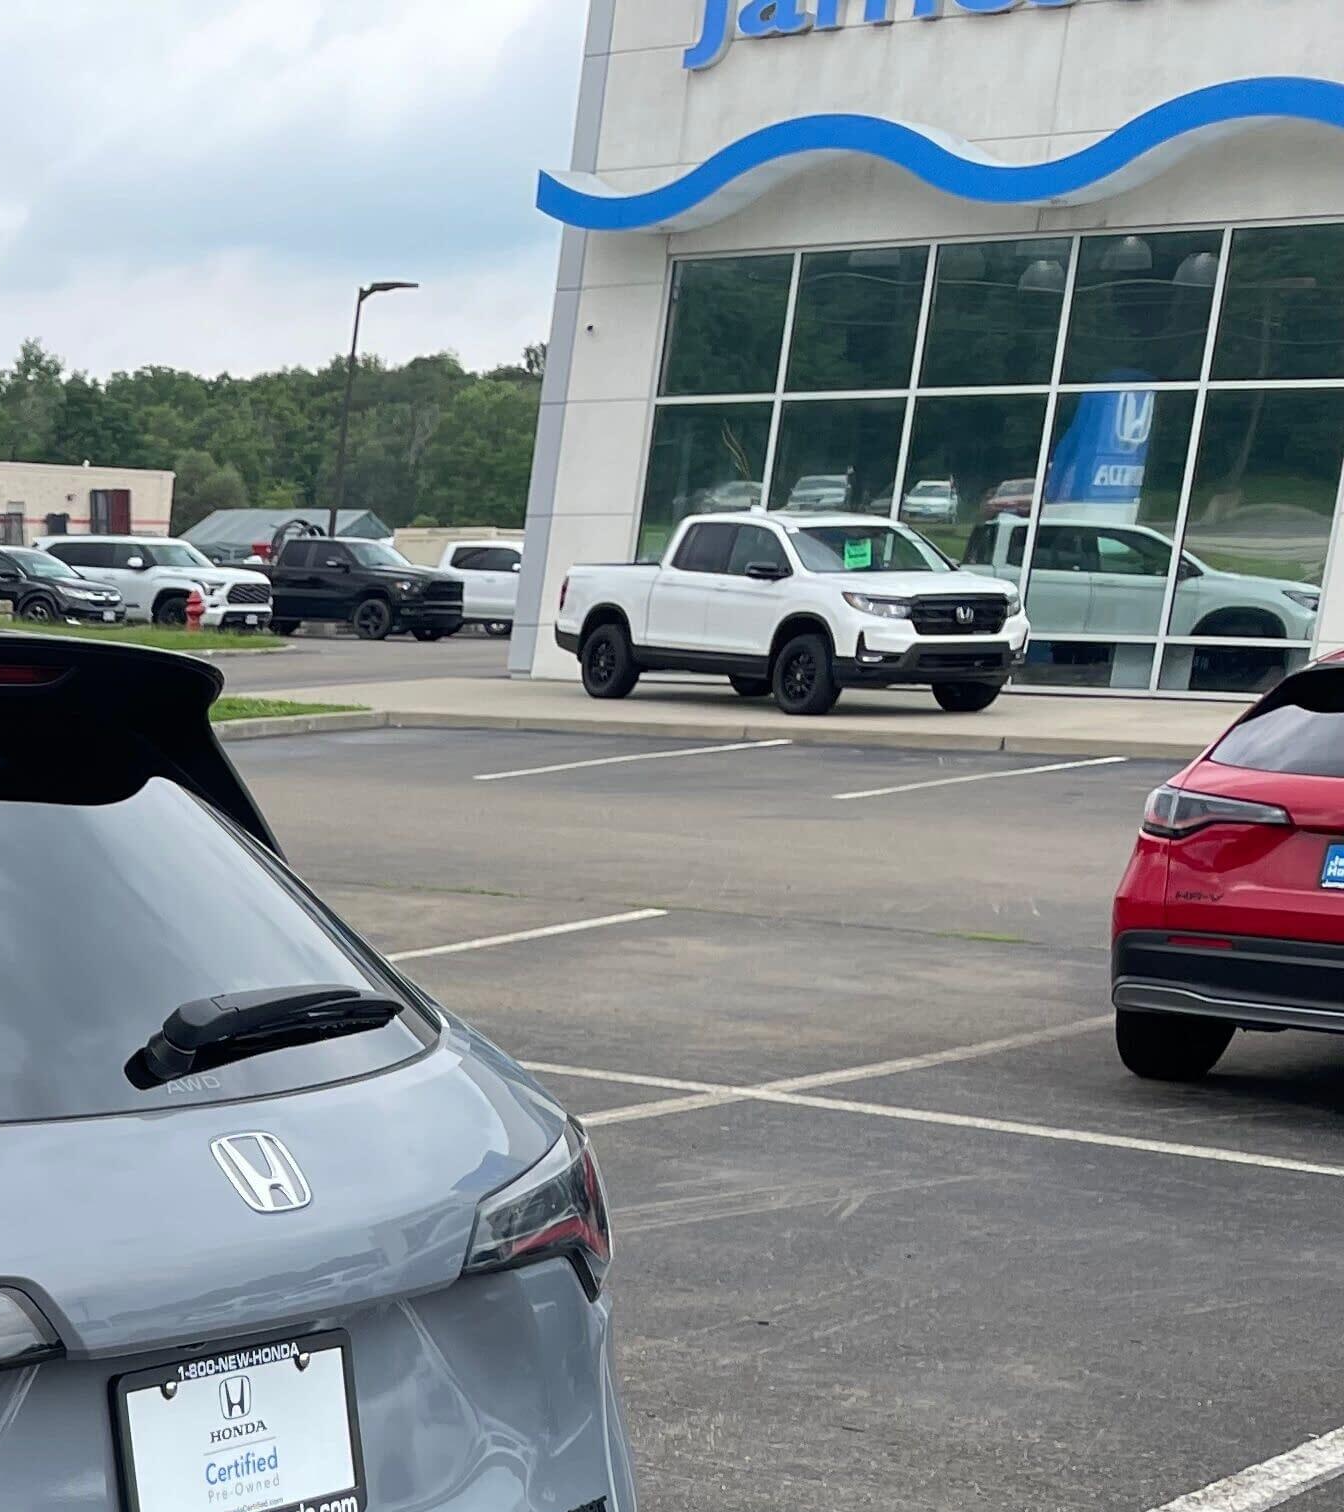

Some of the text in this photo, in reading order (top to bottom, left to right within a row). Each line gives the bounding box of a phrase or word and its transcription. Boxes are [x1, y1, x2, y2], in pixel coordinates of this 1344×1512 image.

[167, 1075, 221, 1095] AWD
[177, 1342, 300, 1381] 1-800-NEW-HONDA
[210, 1420, 267, 1443] HONDA
[206, 1446, 278, 1485] Certified
[207, 1473, 280, 1503] Pre-Owned
